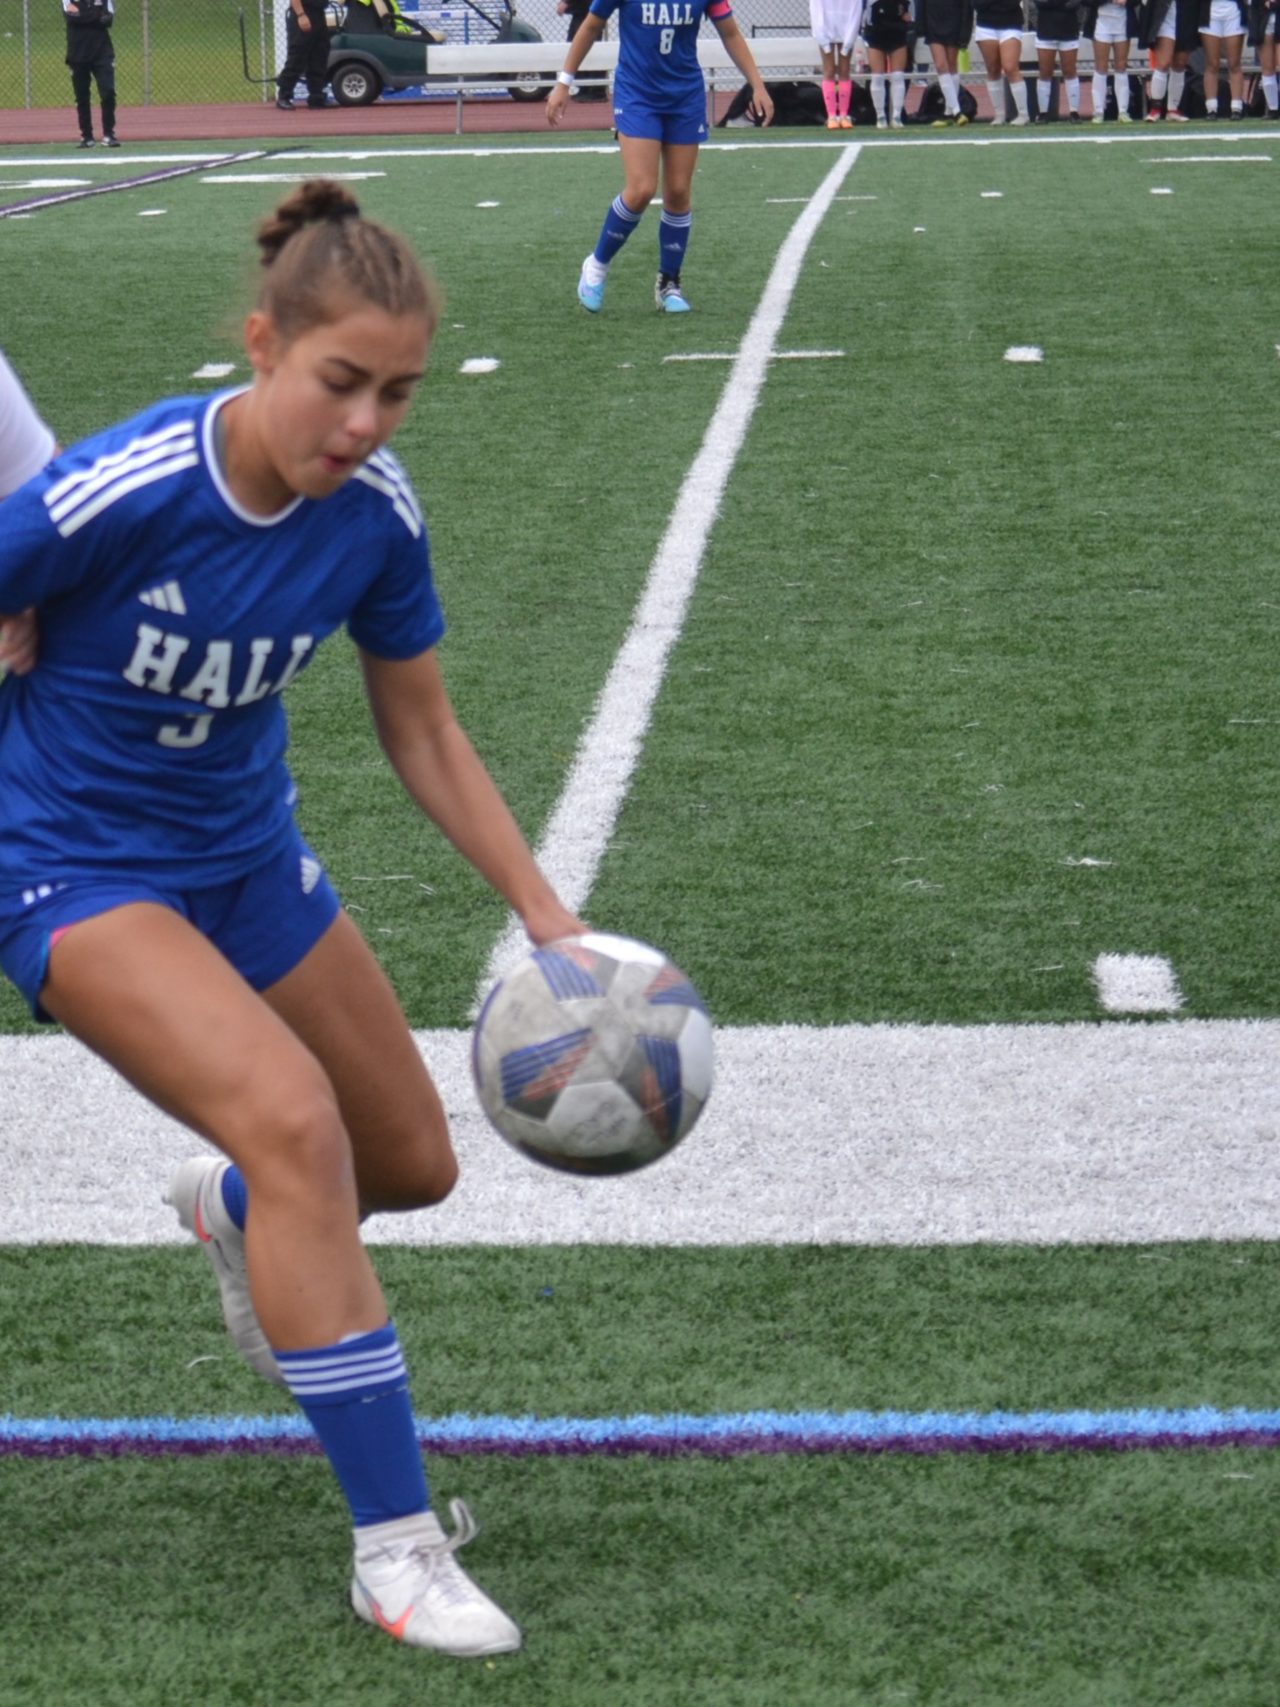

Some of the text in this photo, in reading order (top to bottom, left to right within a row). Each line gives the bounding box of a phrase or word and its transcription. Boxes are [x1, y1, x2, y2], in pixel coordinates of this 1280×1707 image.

[641, 3, 694, 25] HALL
[660, 28, 675, 54] 8
[122, 622, 314, 709] HALL
